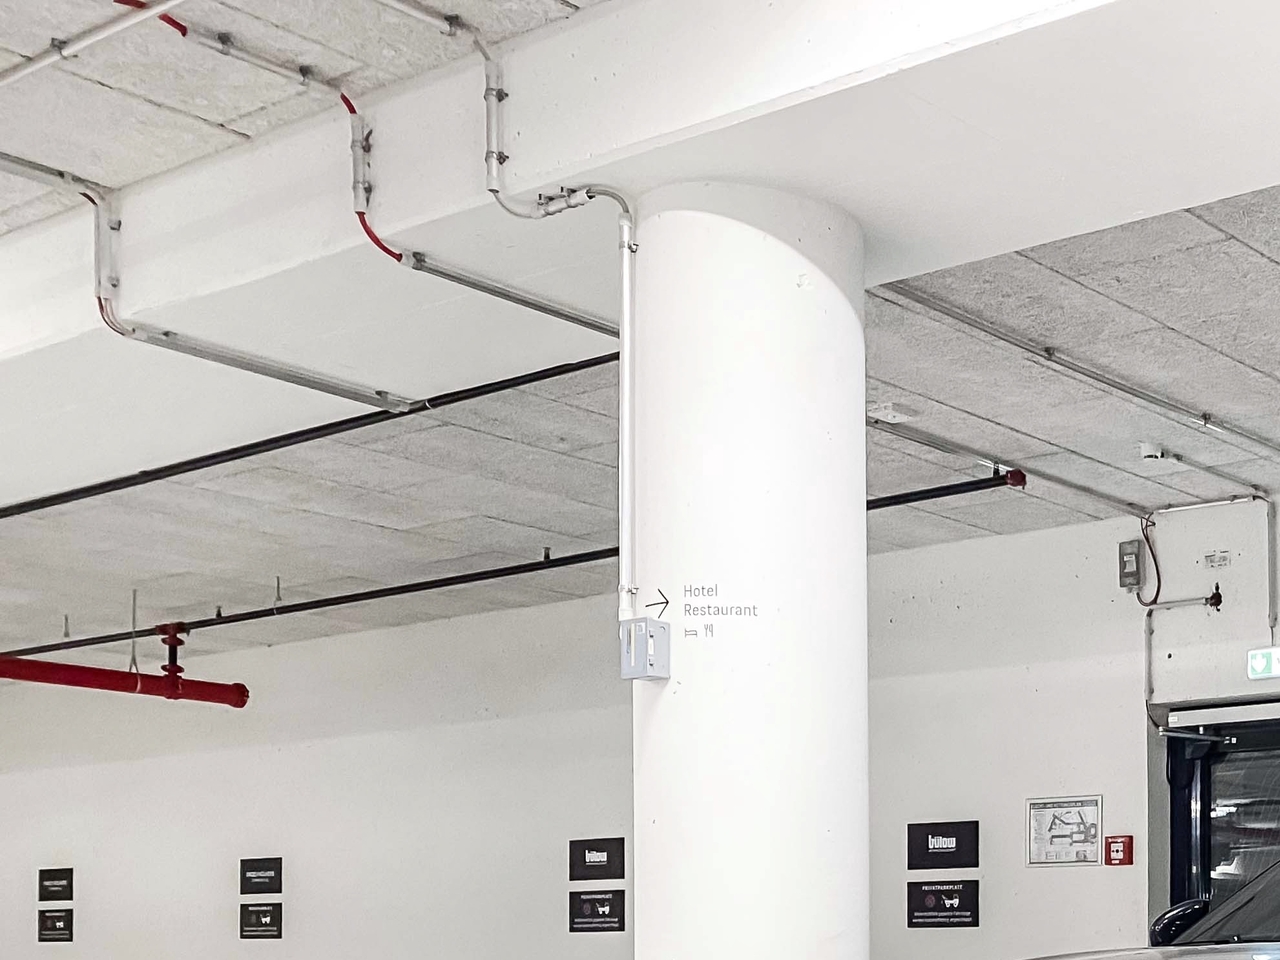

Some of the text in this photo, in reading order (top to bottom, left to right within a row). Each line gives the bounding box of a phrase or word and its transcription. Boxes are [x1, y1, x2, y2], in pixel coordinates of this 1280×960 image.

[683, 584, 718, 598] Hotel
[683, 603, 759, 617] Restaurant
[928, 834, 956, 849] bülow
